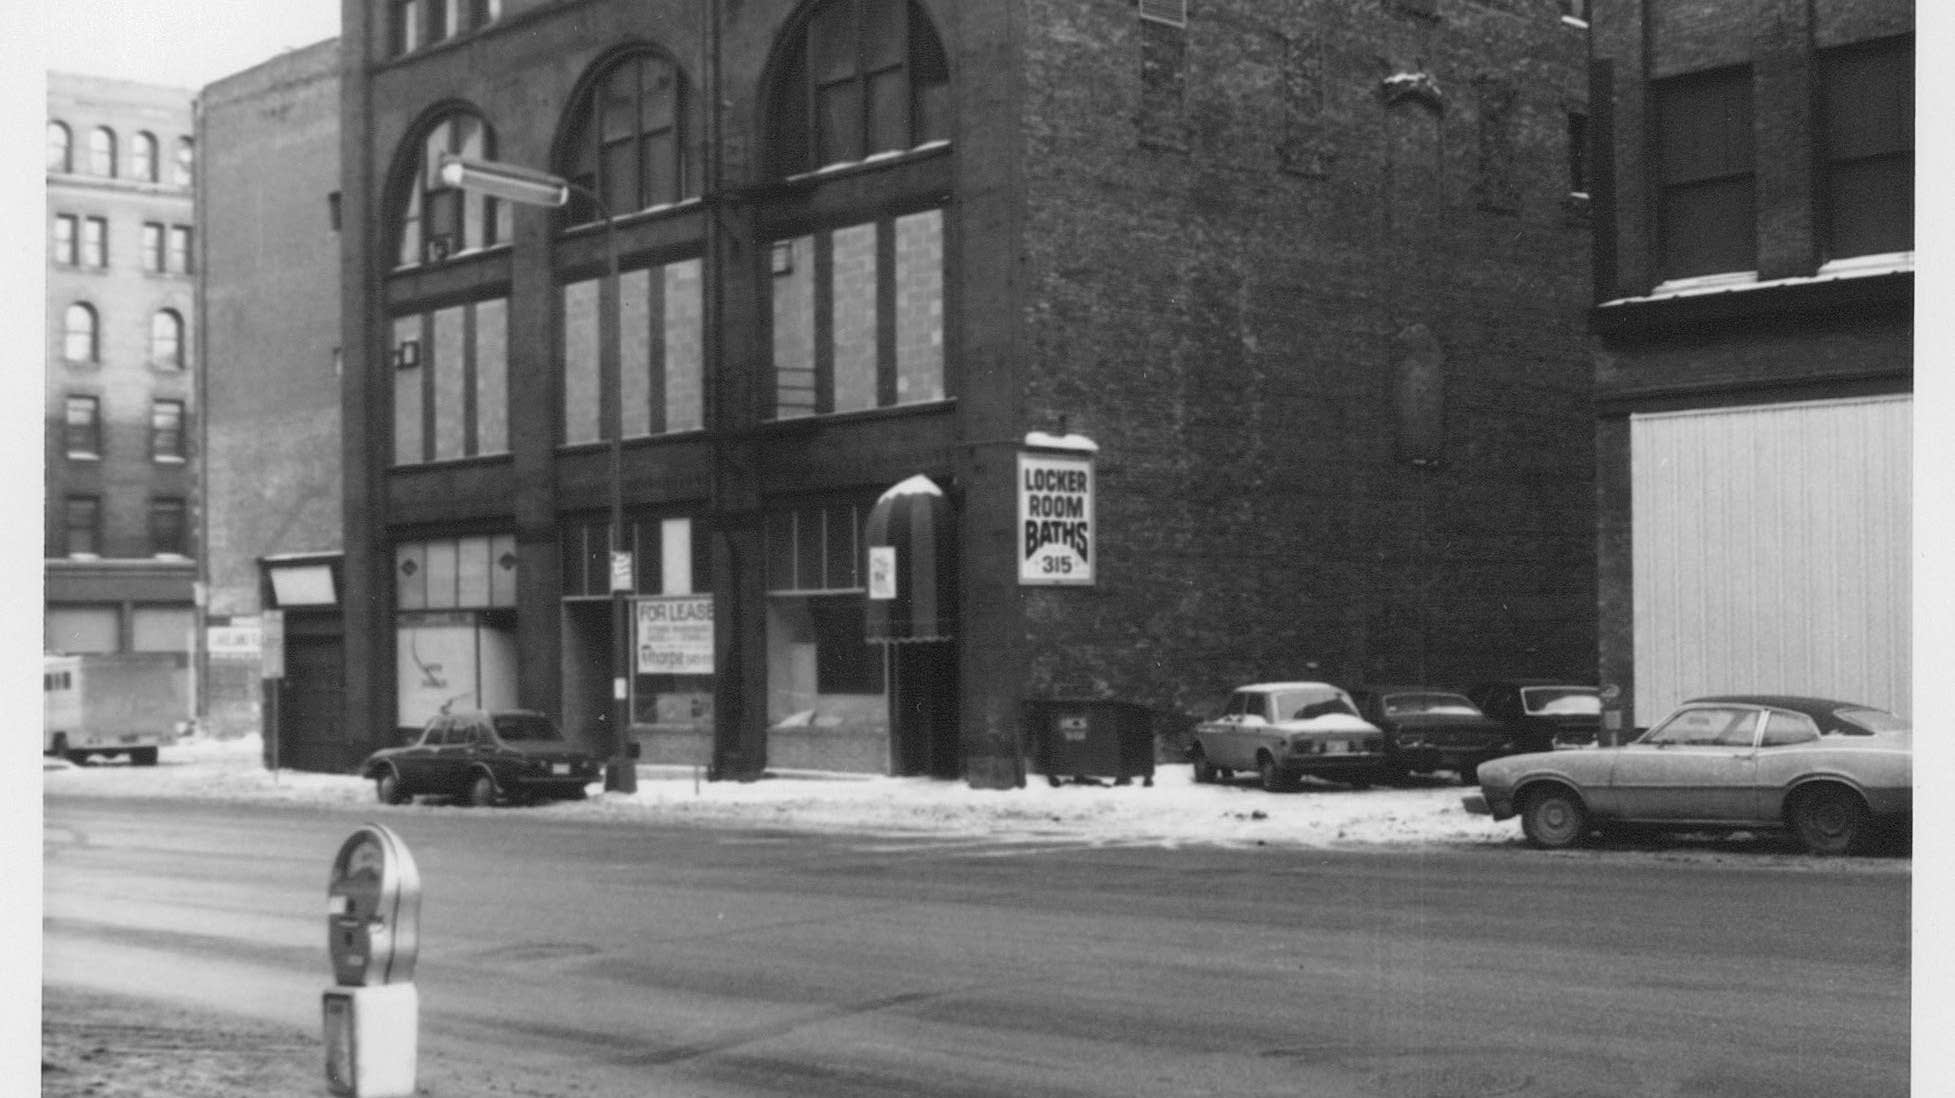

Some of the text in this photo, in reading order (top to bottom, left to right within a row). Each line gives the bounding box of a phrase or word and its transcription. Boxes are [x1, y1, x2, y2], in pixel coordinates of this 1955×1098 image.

[1025, 468, 1087, 493] LOCKER
[1029, 494, 1084, 518] ROOM
[1025, 520, 1088, 563] BATHS
[1042, 555, 1072, 573] 315
[640, 603, 714, 622] FOR LEASE
